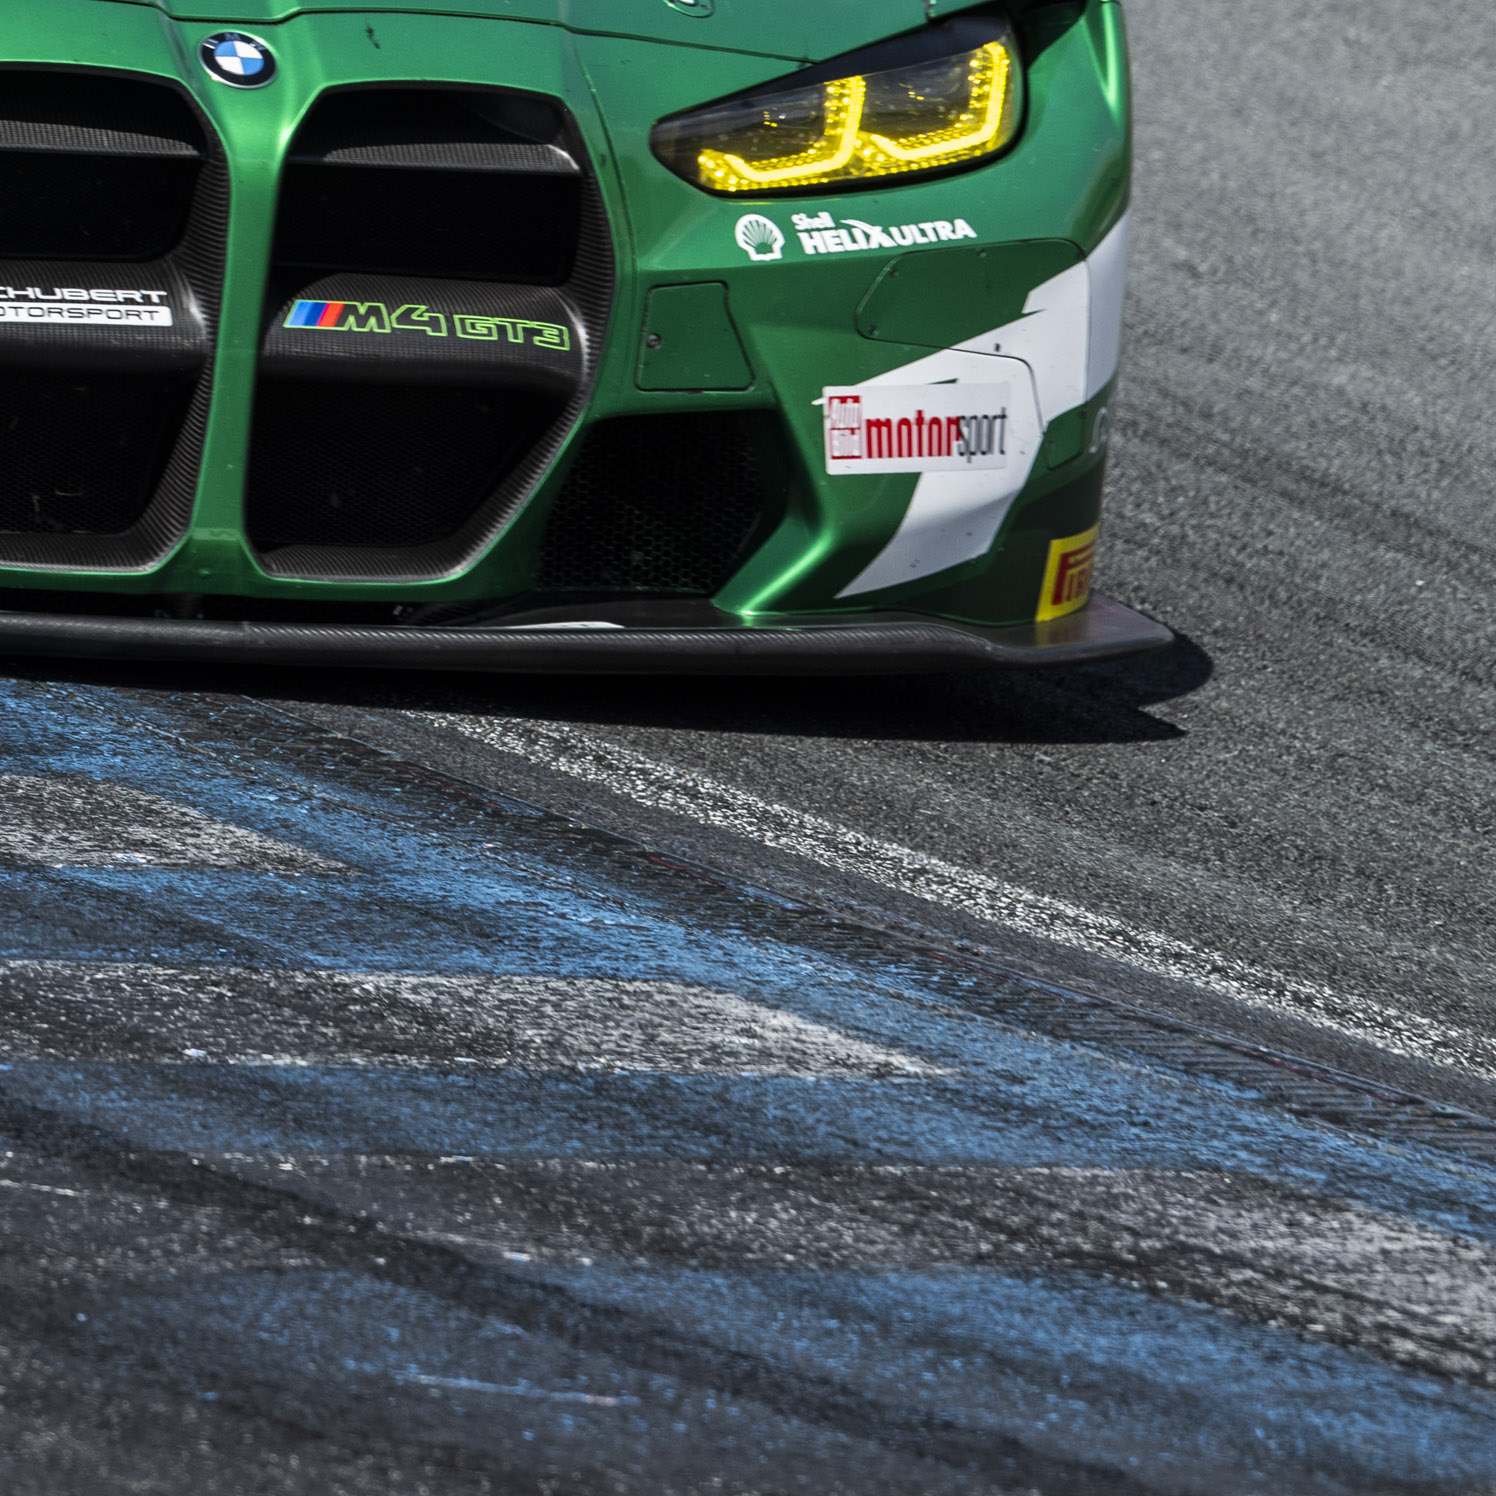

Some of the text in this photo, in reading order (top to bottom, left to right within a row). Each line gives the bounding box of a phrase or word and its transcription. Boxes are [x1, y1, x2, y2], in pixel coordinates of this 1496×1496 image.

[797, 218, 977, 254] HELIX ULTRA
[453, 314, 570, 351] GT3
